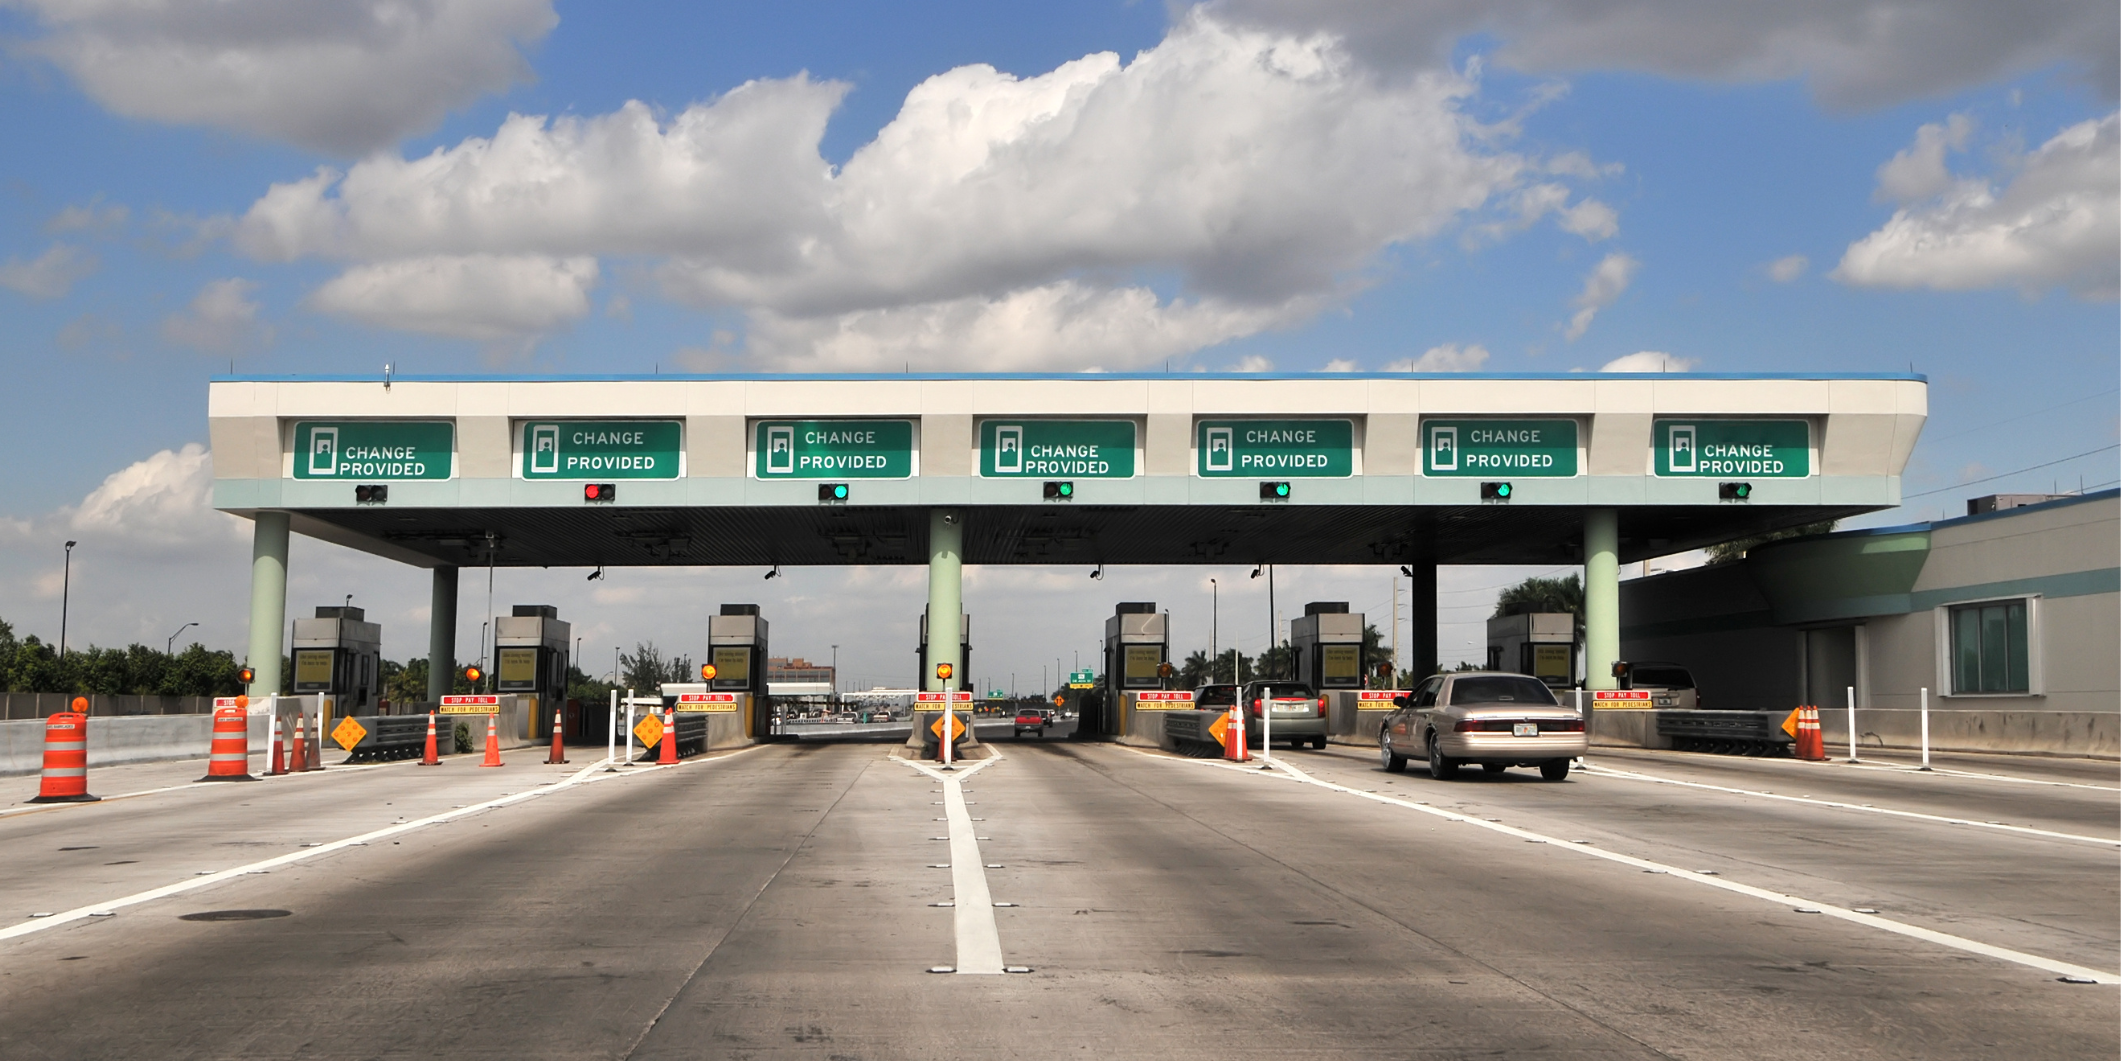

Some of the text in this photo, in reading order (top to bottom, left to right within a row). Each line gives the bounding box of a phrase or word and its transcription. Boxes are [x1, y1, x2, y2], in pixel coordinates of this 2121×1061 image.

[573, 432, 643, 445] CHANGE
[805, 431, 875, 444] CHANGE
[1246, 430, 1316, 443] CHANGE
[1471, 430, 1540, 443] CHANGE
[345, 446, 416, 460] CHANGE
[1030, 444, 1099, 458] CHANGE
[1704, 444, 1774, 458] CHANGE
[567, 456, 655, 470] PROVIDED
[799, 455, 887, 469] PROVIDED
[1025, 460, 1110, 474] PROVIDED
[1242, 454, 1328, 468] PROVIDED
[1466, 454, 1553, 468] PROVIDED
[1699, 460, 1784, 474] PROVIDED
[339, 462, 426, 476] PROVIDED
